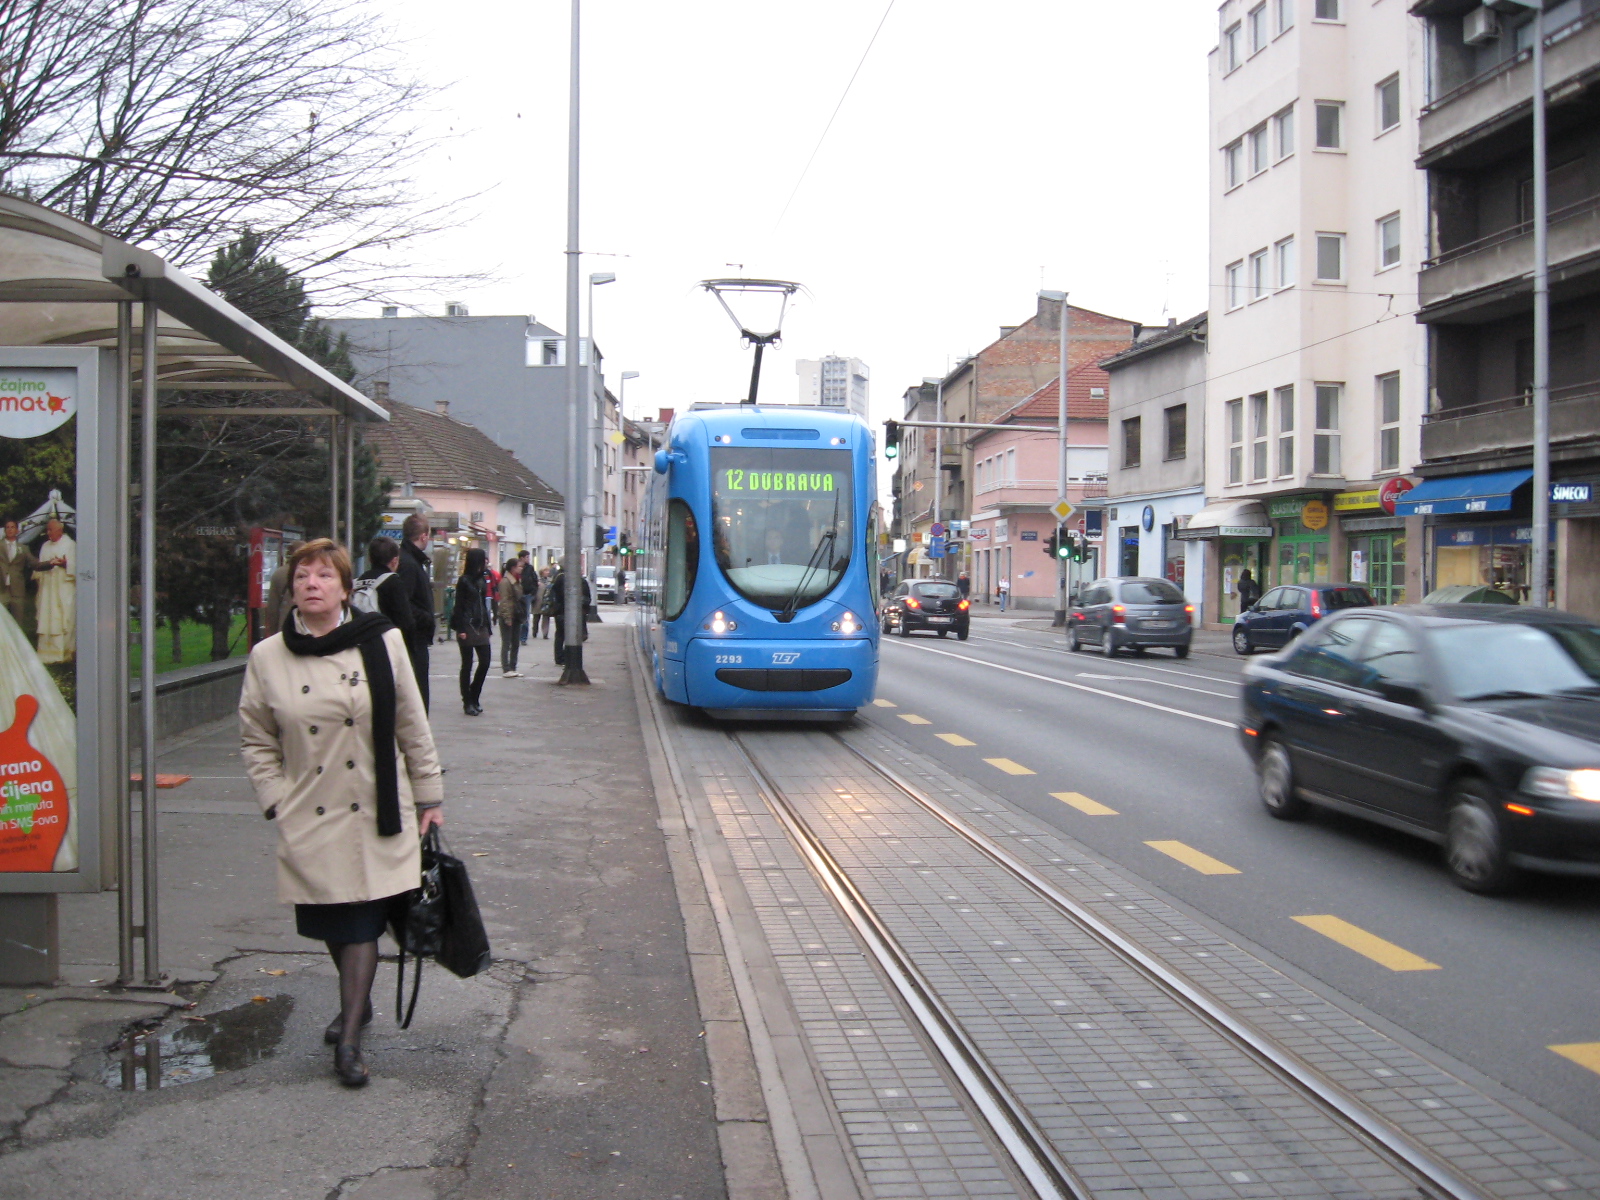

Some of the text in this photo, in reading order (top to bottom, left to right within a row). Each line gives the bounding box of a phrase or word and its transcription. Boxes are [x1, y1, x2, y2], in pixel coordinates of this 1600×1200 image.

[725, 469, 833, 492] 12 DUBRAVA
[1552, 484, 1589, 501] ŠIMECKI
[715, 655, 742, 664] 2293
[0, 780, 54, 799] cijena
